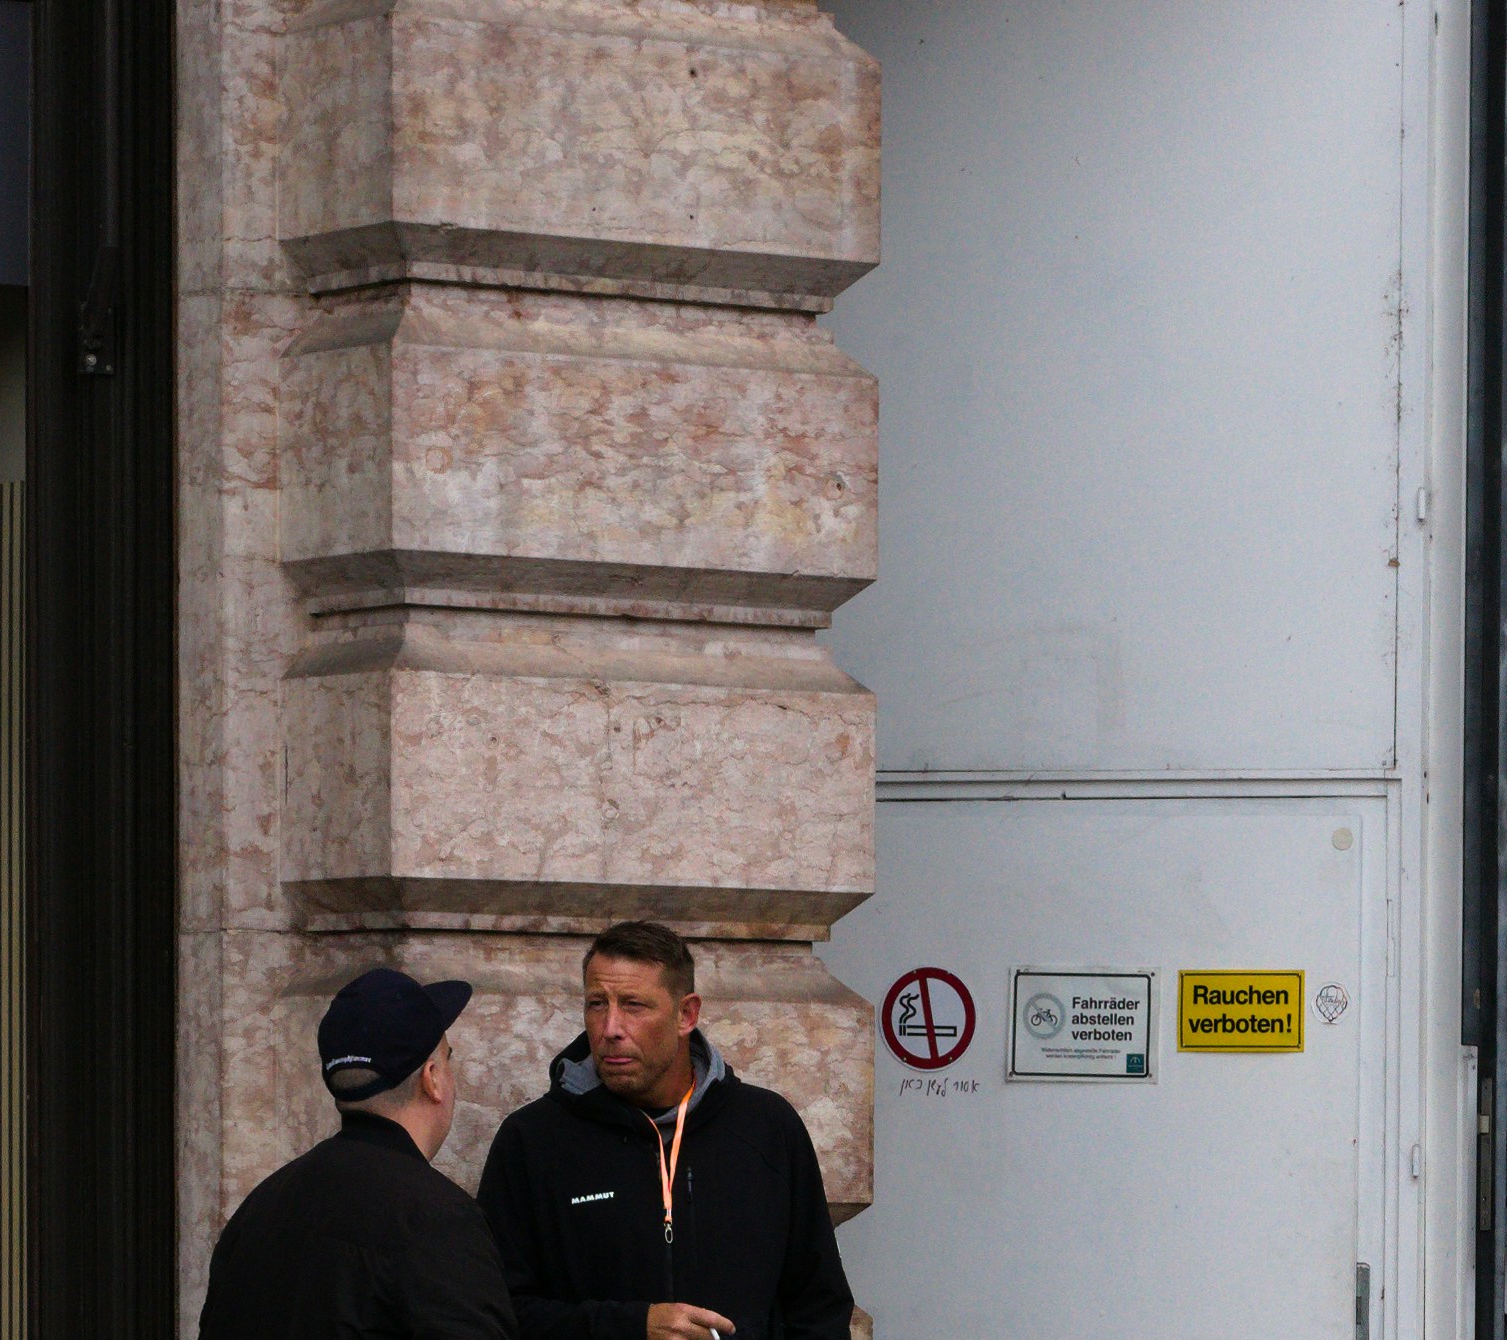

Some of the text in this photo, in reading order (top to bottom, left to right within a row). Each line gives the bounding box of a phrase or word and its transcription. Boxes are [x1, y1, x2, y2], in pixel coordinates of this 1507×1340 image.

[1193, 984, 1289, 1005] Rauchen
[1072, 996, 1140, 1010] Fahrräder
[1071, 1012, 1135, 1026] abstellen
[1188, 1013, 1293, 1034] verboten!
[1071, 1029, 1133, 1041] verboten
[571, 1191, 615, 1205] MAMMUT
